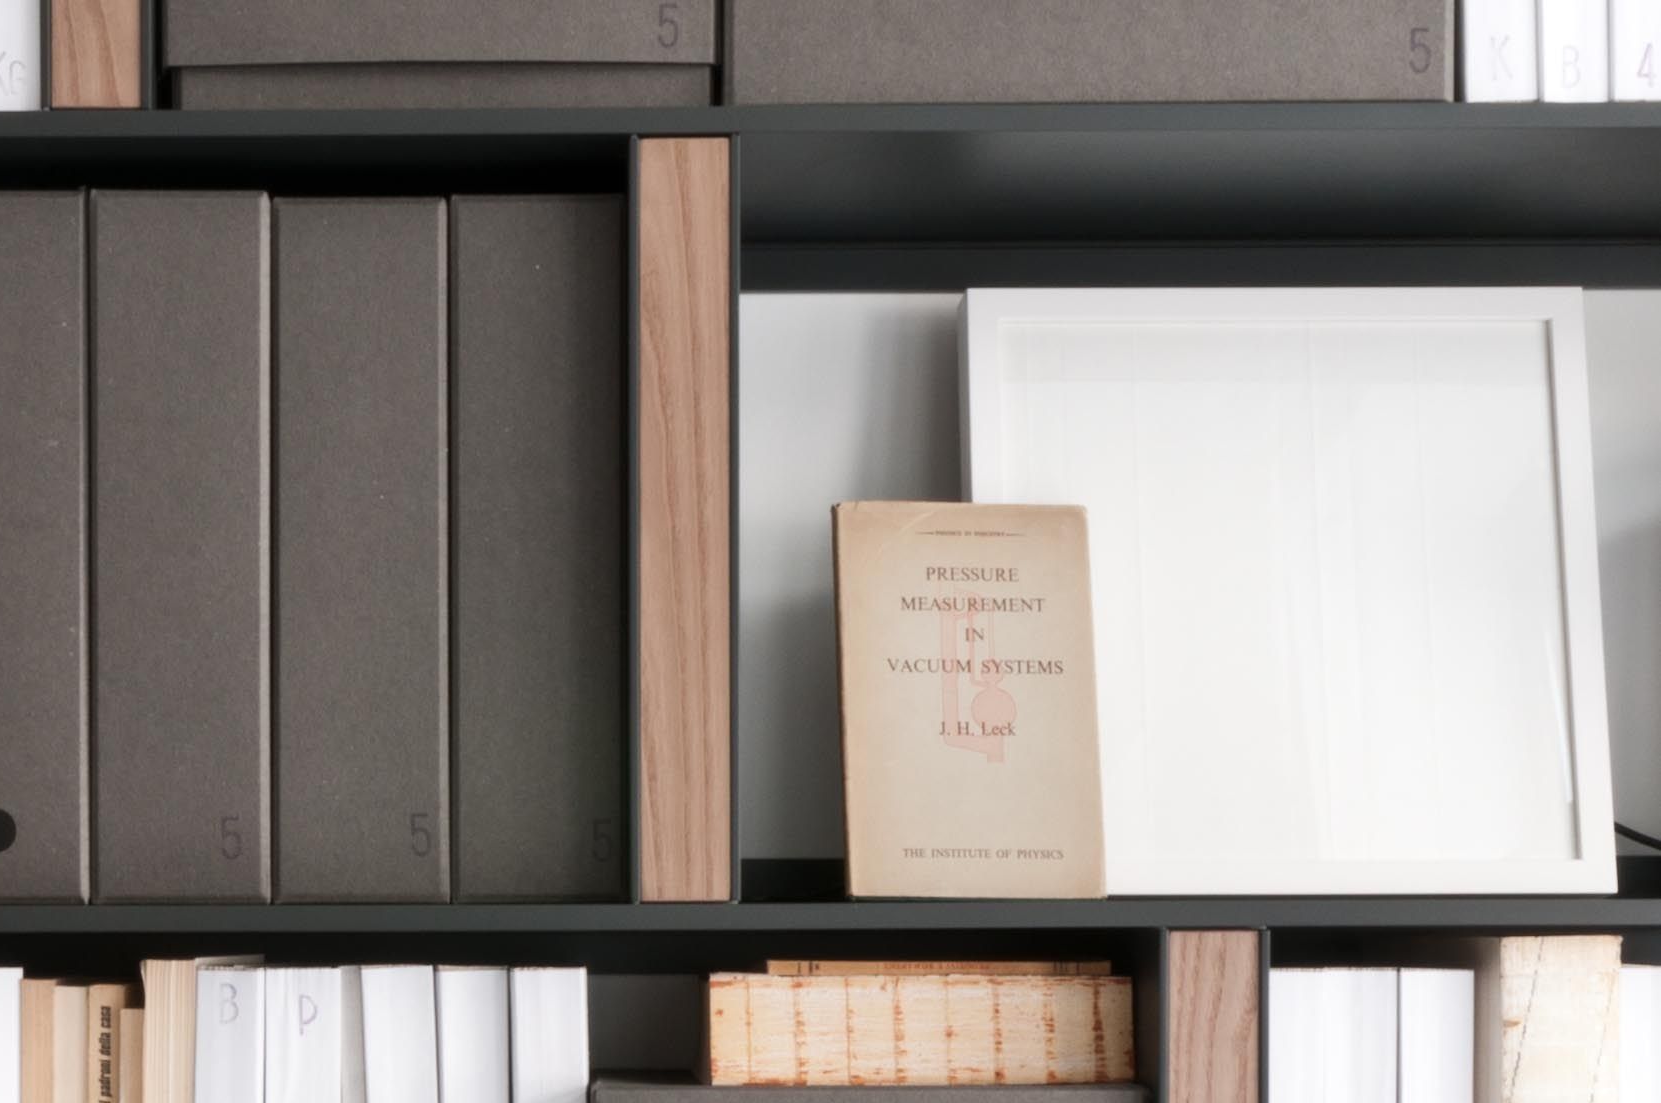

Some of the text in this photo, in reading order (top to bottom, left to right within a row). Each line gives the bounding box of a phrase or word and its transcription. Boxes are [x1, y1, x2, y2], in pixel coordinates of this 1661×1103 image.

[657, 2, 679, 49] 5
[1407, 27, 1433, 75] 5
[925, 565, 1020, 583] PRESSURE
[899, 595, 1047, 613] MEASUREMENT
[964, 627, 985, 642] IN
[886, 657, 1065, 676] VACUUM SYSTEMS
[939, 720, 1017, 737] J. H. Leck
[219, 815, 244, 861] 5
[409, 812, 432, 858] 5
[901, 848, 1066, 861] THE INSTITUTE OF PHYSICS
[218, 982, 240, 1025] B
[298, 993, 319, 1037] P
[99, 1005, 112, 1029] casa
